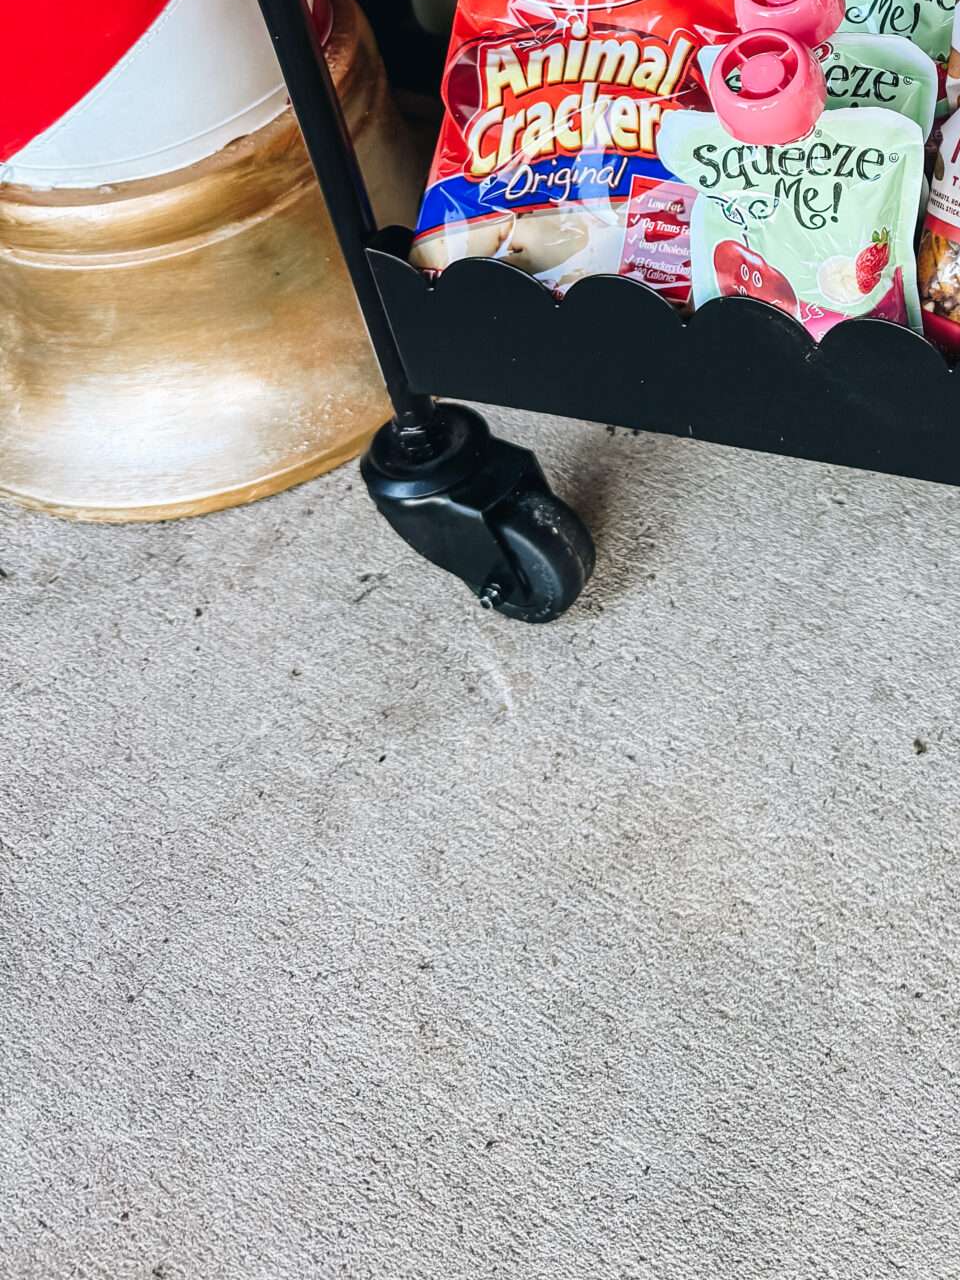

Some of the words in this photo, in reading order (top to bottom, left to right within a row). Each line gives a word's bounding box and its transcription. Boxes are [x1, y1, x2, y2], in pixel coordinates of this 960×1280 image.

[486, 23, 695, 110] Animal
[504, 156, 629, 203] Original
[648, 198, 666, 210] Low
[666, 199, 683, 213] Fat
[749, 177, 844, 230] Me!
[655, 218, 681, 234] Trans
[646, 267, 677, 282] Calories
